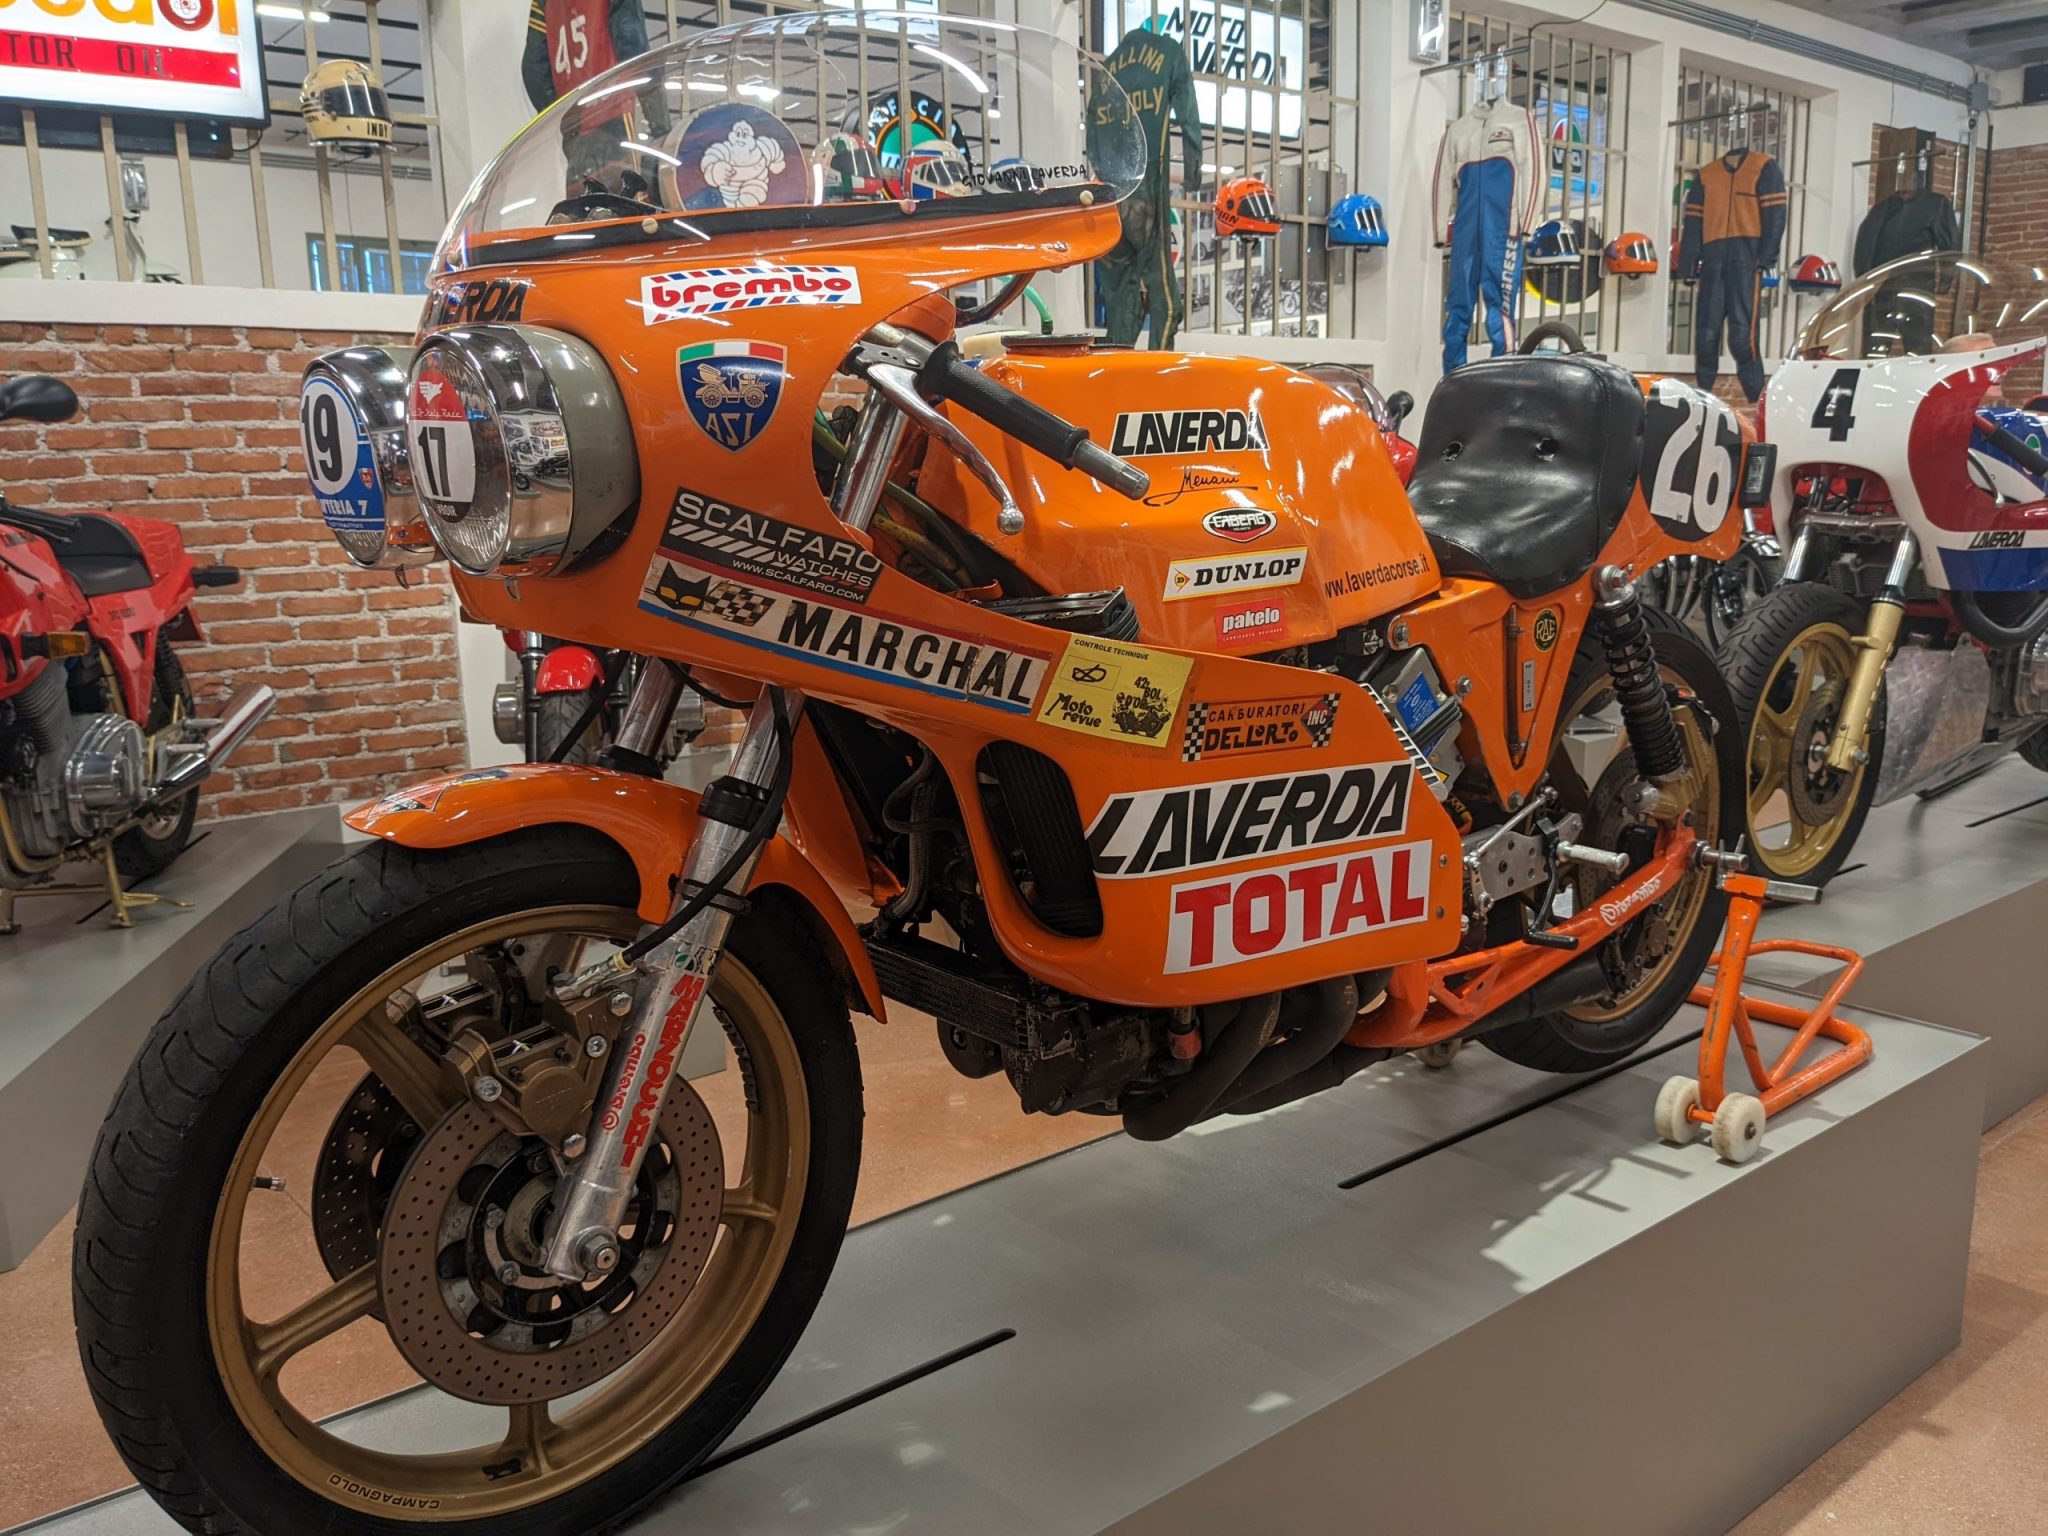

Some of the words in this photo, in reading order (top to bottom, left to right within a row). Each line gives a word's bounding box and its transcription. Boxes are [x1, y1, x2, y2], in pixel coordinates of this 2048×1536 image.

[556, 14, 588, 74] 45
[962, 168, 1027, 187] GIOVANNI
[1032, 163, 1086, 181] LAVERDA
[652, 273, 852, 308] brembo
[1811, 368, 1861, 442] 4
[301, 393, 344, 483] 19
[704, 412, 755, 447] ASI
[1112, 410, 1271, 456] LAVERDA
[417, 425, 452, 498] 17
[1650, 377, 1739, 533] 26
[358, 499, 368, 516] 7
[675, 492, 881, 574] SCALFARO
[1968, 529, 2026, 550] LAVERDA
[776, 550, 873, 587] WATCHES
[1193, 557, 1301, 587] DUNLOP
[1222, 607, 1280, 634] pakelo
[778, 599, 1033, 704] MARCHAL
[1074, 638, 1112, 653] CONTROLE
[1113, 647, 1149, 660] TECHNIQUE
[1044, 692, 1093, 716] Moto
[1143, 686, 1162, 700] BOL
[1062, 710, 1102, 728] revue
[1307, 709, 1328, 726] INC
[1088, 763, 1412, 875] LAVERDA
[1175, 848, 1425, 968] TOTAL
[610, 1033, 647, 1110] brembo
[620, 973, 705, 1168] MARZOCCHI
[329, 1473, 440, 1510] CAMPAGNOLO
